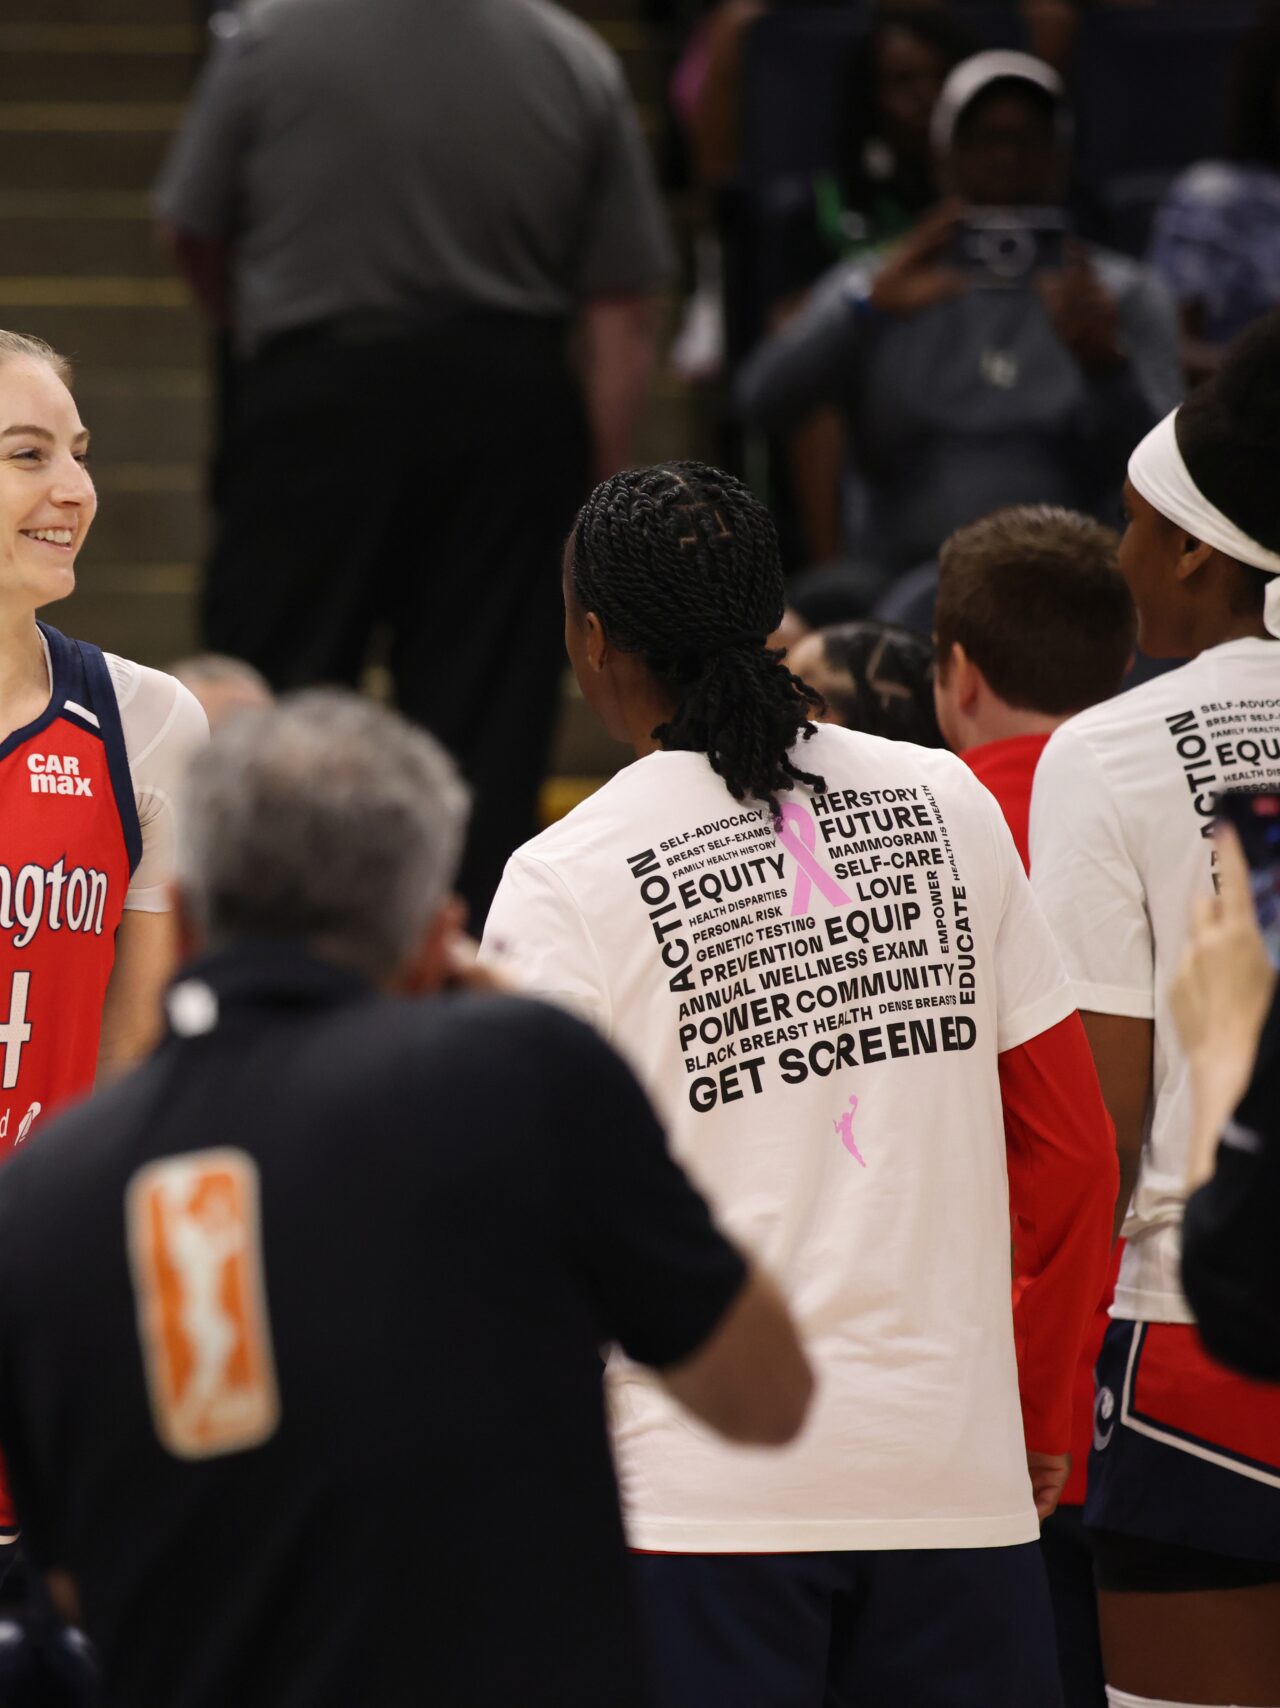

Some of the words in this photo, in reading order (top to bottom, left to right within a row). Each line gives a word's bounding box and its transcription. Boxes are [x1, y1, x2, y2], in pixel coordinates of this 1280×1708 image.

[1205, 714, 1247, 728] BREAST
[1250, 713, 1280, 721] SELF-
[1210, 728, 1245, 739] FAMILY
[27, 753, 80, 775] CAR
[1223, 770, 1264, 782] HEALTH
[30, 773, 93, 797] max
[810, 788, 918, 817] HERSTORY
[921, 784, 944, 824] WEALTH
[660, 809, 764, 852] SELF-ADVOCACY
[819, 805, 933, 843] FUTURE
[666, 845, 706, 866] BREAST
[707, 826, 771, 851] SELF-EXAMS
[672, 861, 705, 879] FAMILY
[707, 850, 739, 866] HEALTH
[740, 840, 777, 856] HISTORY
[828, 831, 938, 860] MAMMOGRAM
[834, 847, 944, 880] SELF-CARE
[945, 839, 961, 881] HEALTH
[678, 853, 785, 909] EQUITY
[856, 874, 917, 901] LOVE
[627, 848, 696, 993] ACTION
[688, 906, 727, 927] HEALTH
[728, 888, 788, 912] DISPARITIES
[692, 915, 754, 944] PERSONAL
[756, 906, 783, 922] RISK
[825, 902, 921, 946] EQUIP
[926, 870, 950, 954] EMPOWER
[696, 932, 754, 962] GENETIC
[758, 917, 816, 941] TESTING
[952, 886, 976, 1005] EDUCATE
[679, 978, 756, 1022] ANNUAL
[759, 948, 868, 989] WELLNESS
[872, 939, 928, 963] EXAM
[700, 935, 824, 987] PREVENTION
[679, 993, 794, 1052] POWER
[796, 963, 954, 1013] COMMUNITY
[879, 1000, 914, 1014] DENSE
[915, 995, 957, 1009] BREASTS
[685, 1043, 737, 1073] BLACK
[740, 1022, 809, 1053] BREAST
[813, 1006, 873, 1034] HEALTH
[689, 1056, 766, 1113] GET
[779, 1015, 977, 1084] SCREENED
